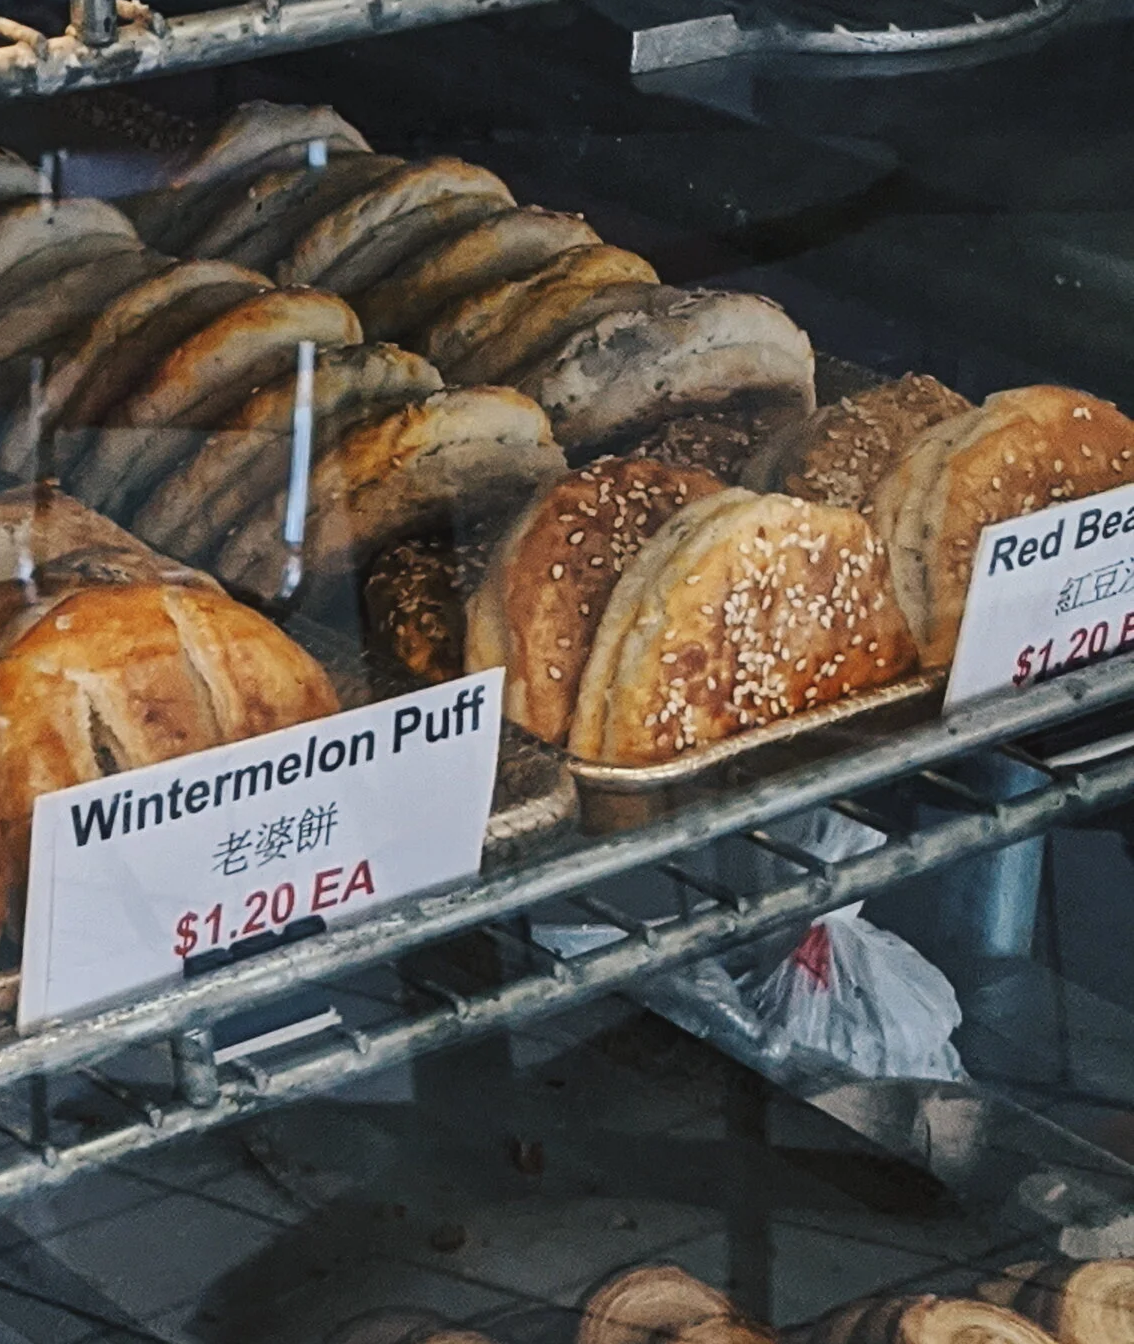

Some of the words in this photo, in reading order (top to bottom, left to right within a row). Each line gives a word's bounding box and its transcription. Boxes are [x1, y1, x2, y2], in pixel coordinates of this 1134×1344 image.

[988, 518, 1065, 577] Red
[1013, 621, 1109, 687] $1.20
[70, 730, 375, 847] Wintermelon
[392, 685, 486, 753] Puff
[211, 801, 338, 876] 老婆餅
[174, 882, 295, 959] $1.20
[310, 859, 375, 913] EA
